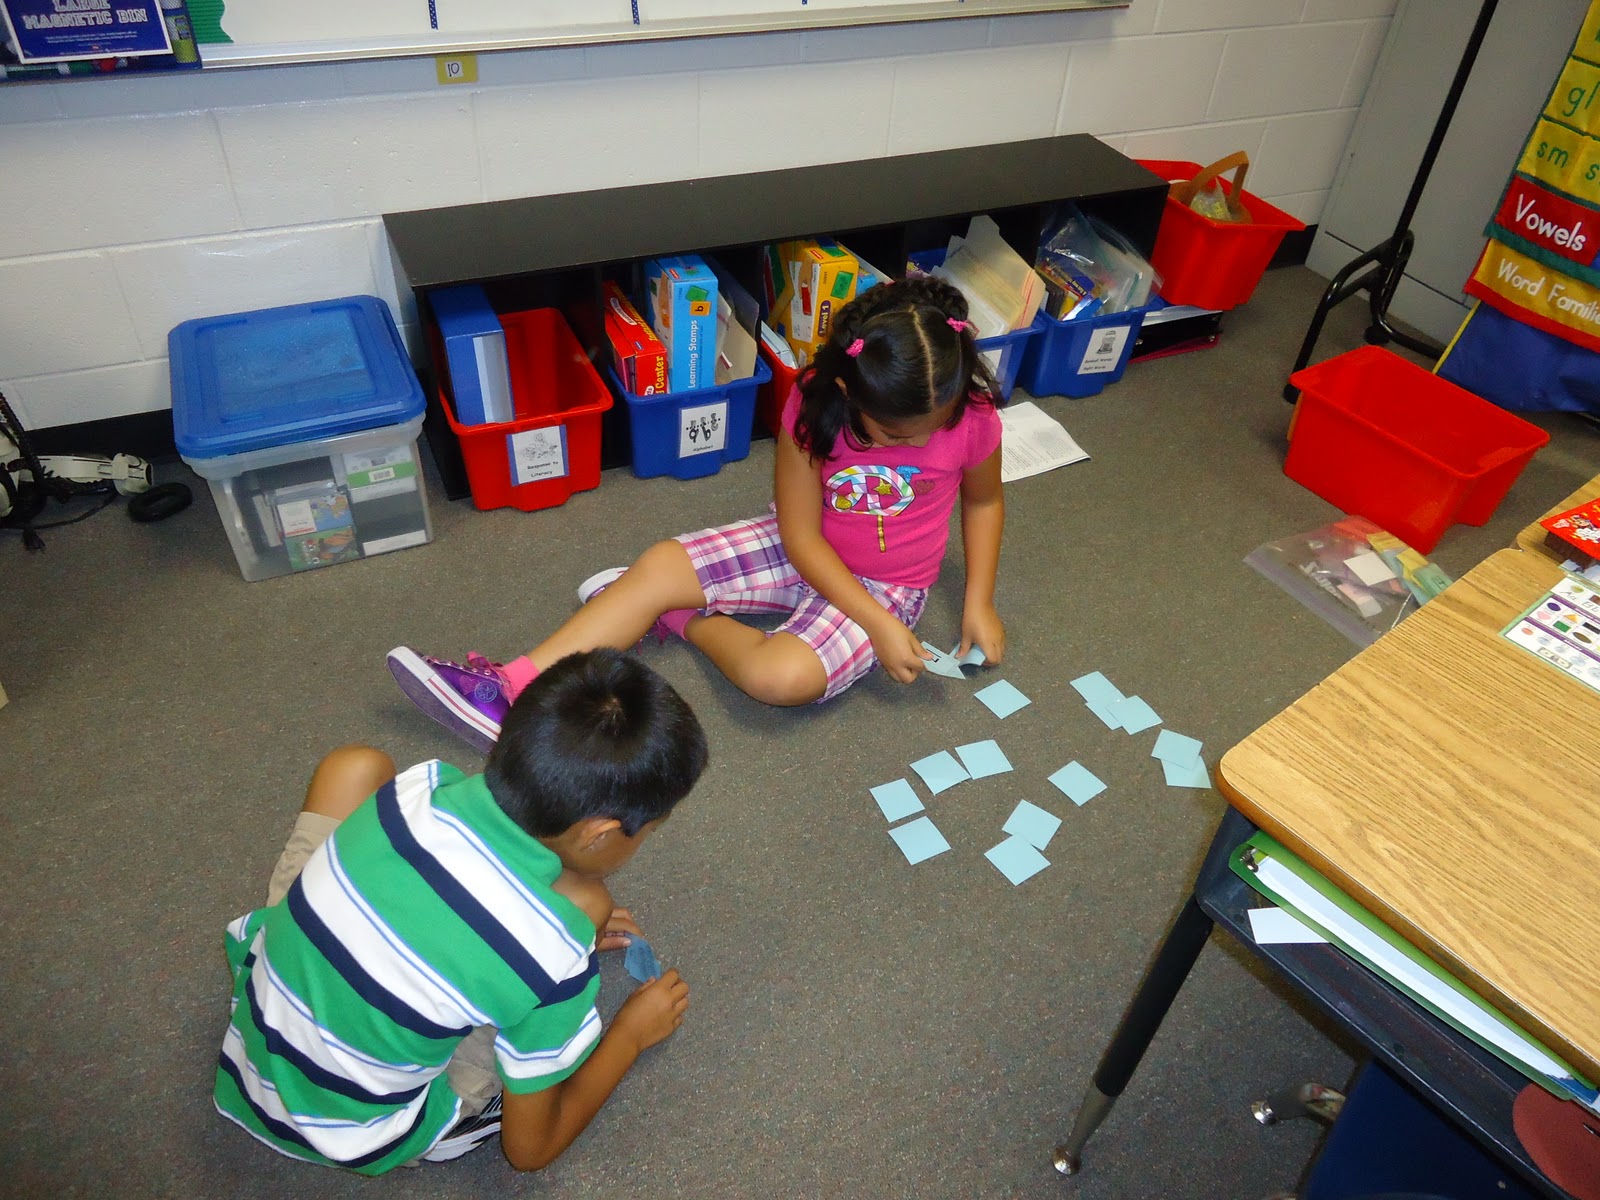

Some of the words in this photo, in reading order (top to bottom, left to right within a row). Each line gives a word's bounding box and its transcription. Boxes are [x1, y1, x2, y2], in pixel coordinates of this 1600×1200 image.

[54, 0, 111, 12] LARGE
[22, 11, 113, 30] MAGNETIC
[116, 8, 149, 24] BIN
[447, 62, 460, 77] 10
[1536, 141, 1569, 169] sm
[1515, 193, 1586, 251] Vowels
[1498, 258, 1546, 297] Word
[688, 319, 699, 351] Stamps
[819, 312, 829, 334] Level
[654, 355, 665, 389] Center
[688, 353, 698, 389] Learning
[527, 462, 551, 470] Response
[530, 470, 553, 478] Literacy
